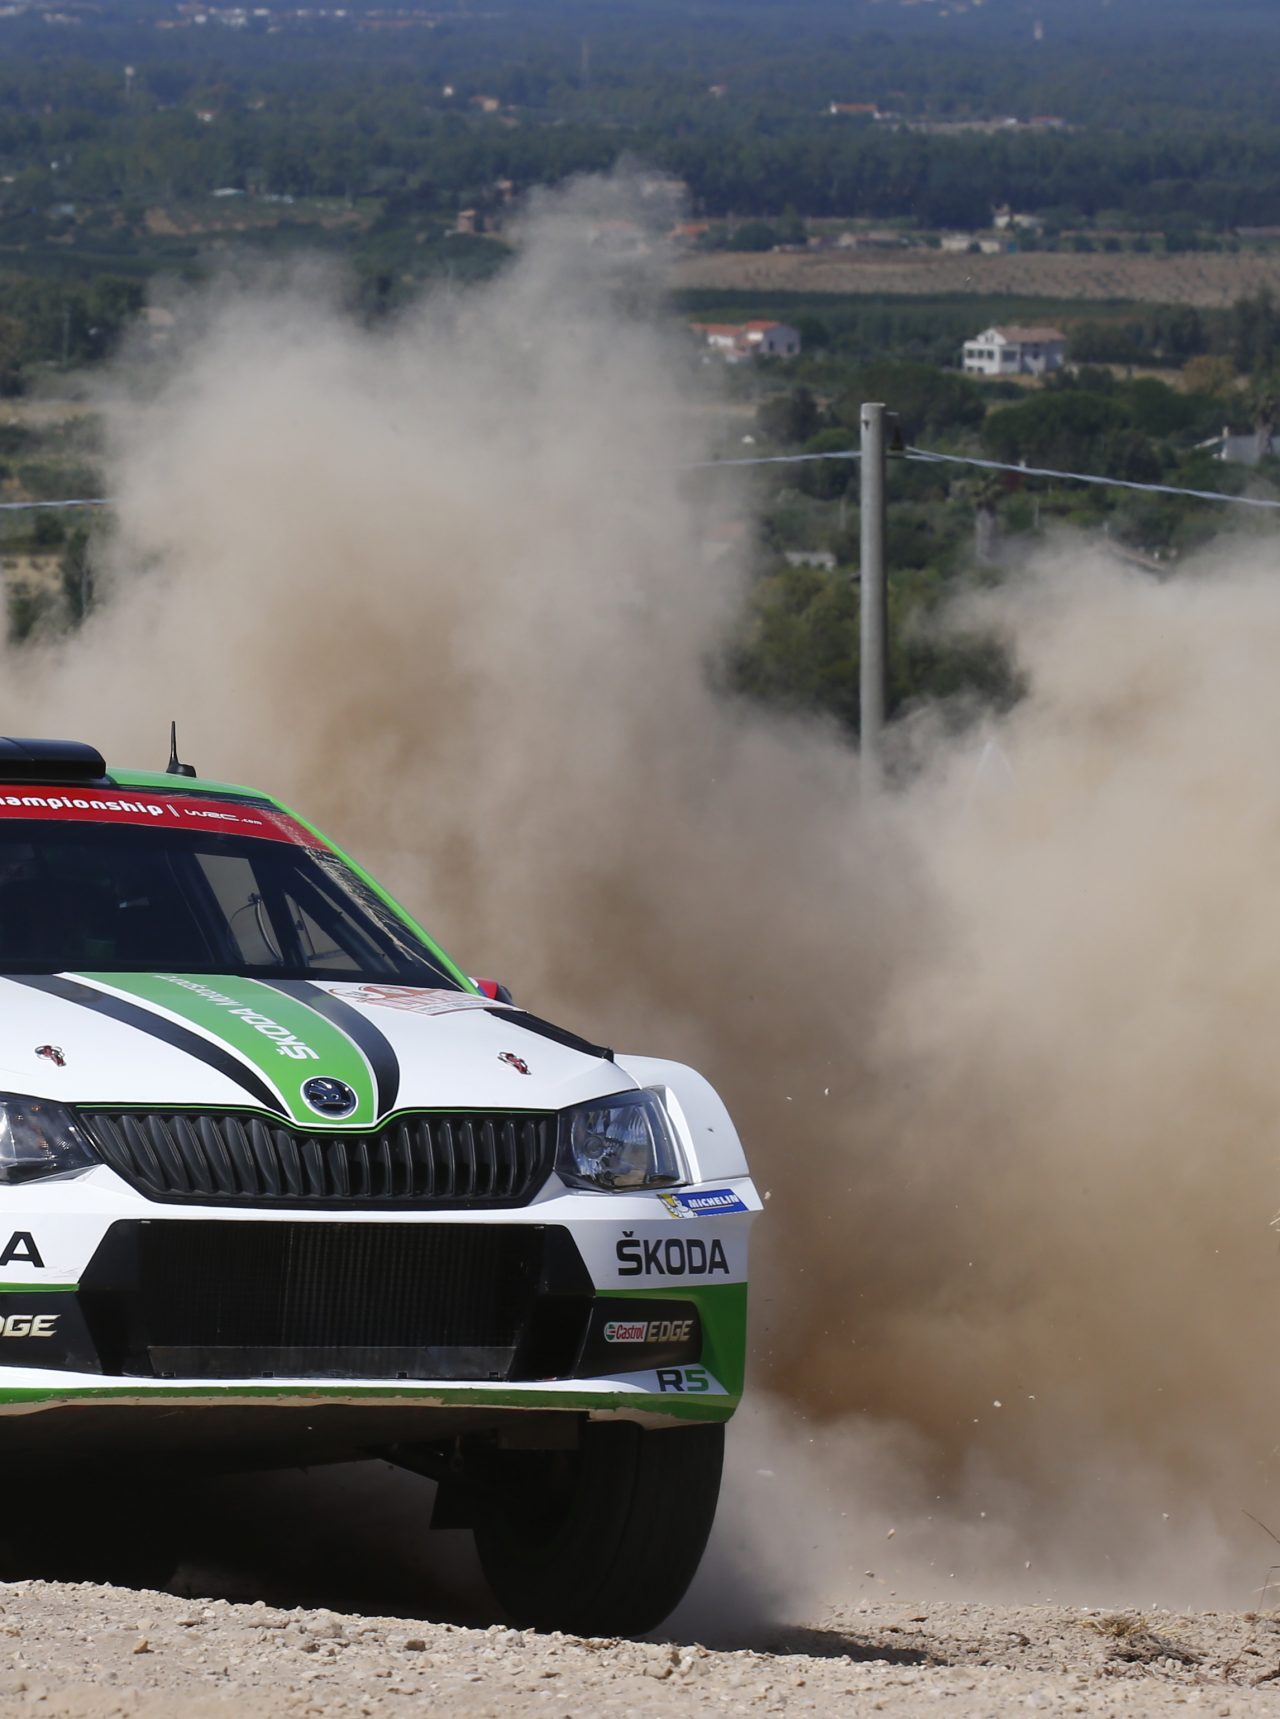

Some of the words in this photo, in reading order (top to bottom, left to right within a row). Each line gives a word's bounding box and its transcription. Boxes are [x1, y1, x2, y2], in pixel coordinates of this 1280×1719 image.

[227, 1007, 320, 1060] ŠKODA
[687, 1193, 740, 1209] MICHELIN
[615, 1230, 731, 1276] ŠKODA
[615, 1322, 645, 1341] Castrol
[645, 1319, 694, 1343] EDGE
[655, 1368, 710, 1393] R5
